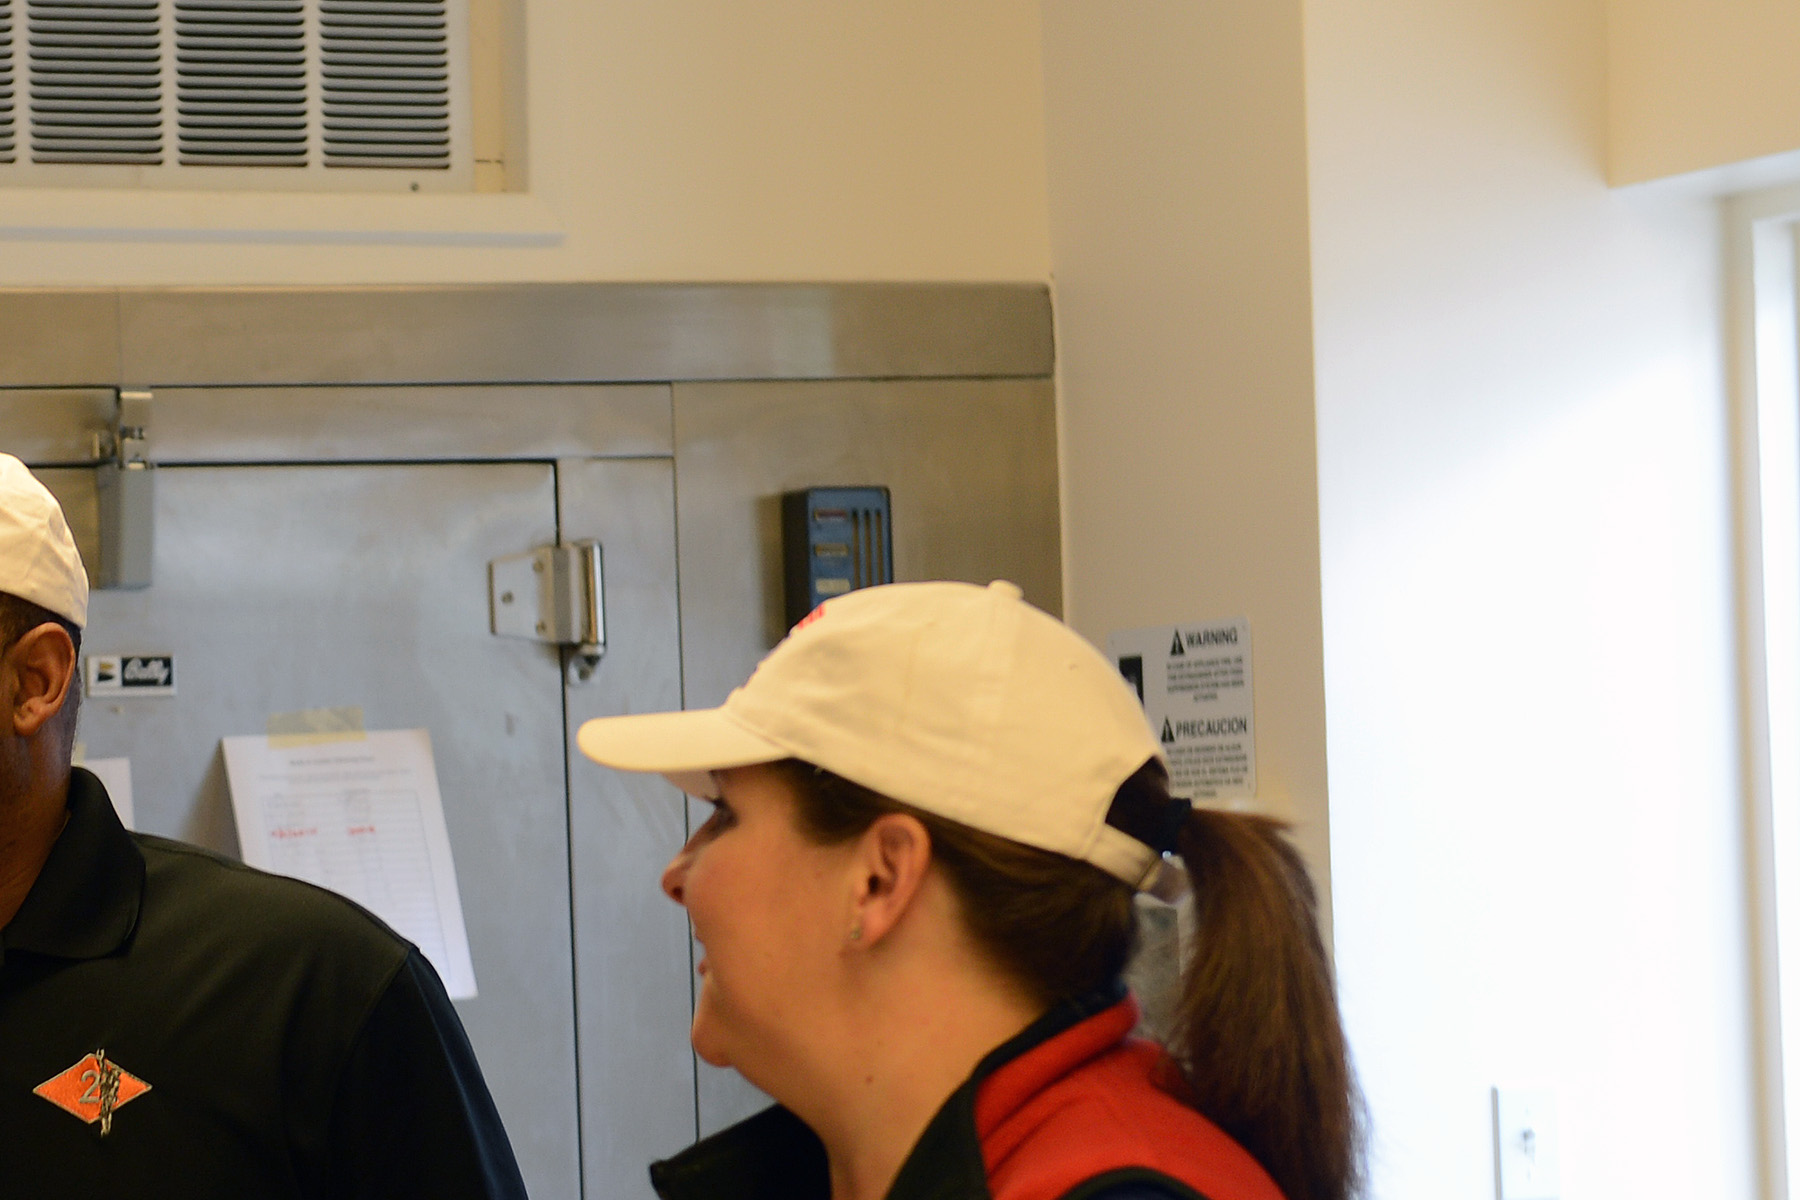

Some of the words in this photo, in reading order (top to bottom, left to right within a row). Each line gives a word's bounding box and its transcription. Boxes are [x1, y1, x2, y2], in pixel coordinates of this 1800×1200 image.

[1185, 626, 1238, 648] WARNING
[1175, 716, 1247, 738] PRECAUCION
[78, 1069, 101, 1104] 2
